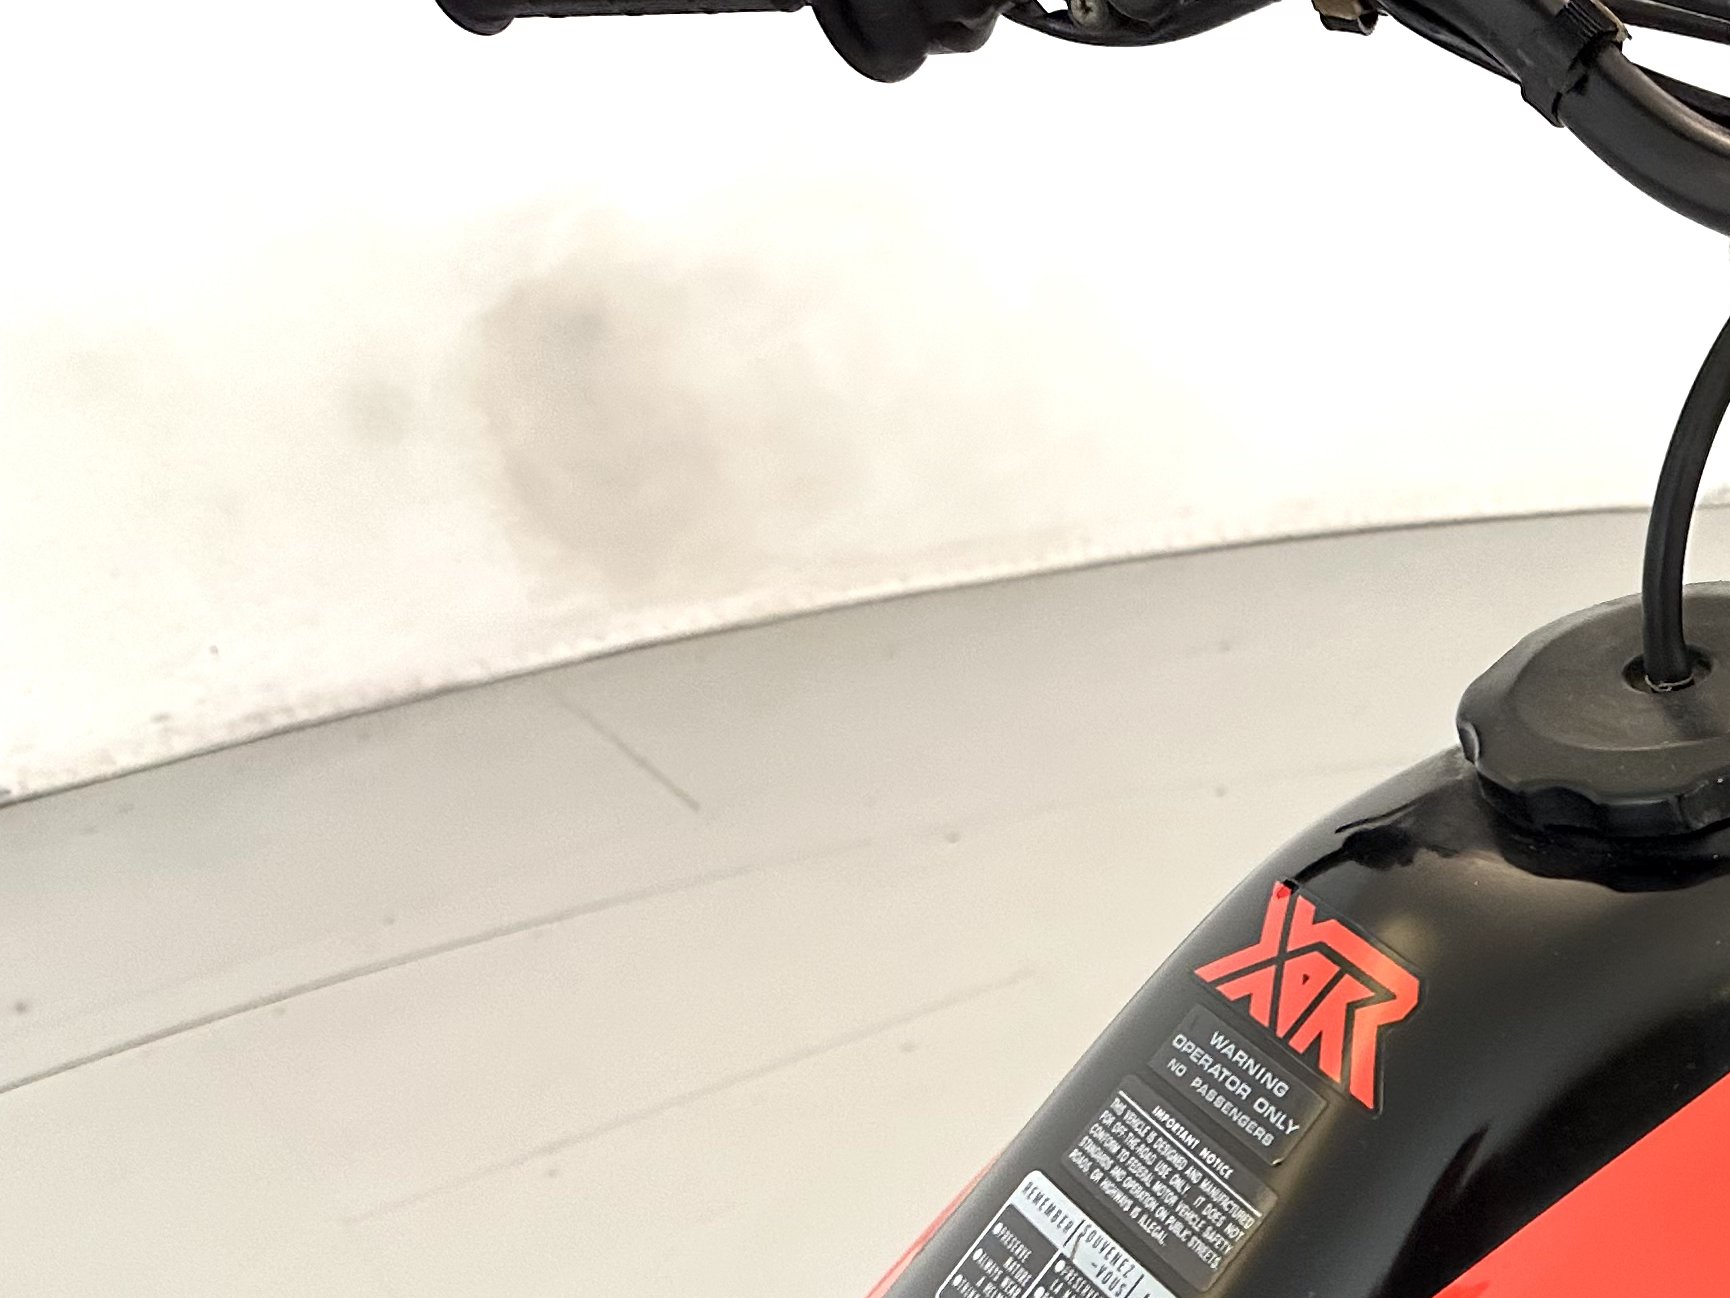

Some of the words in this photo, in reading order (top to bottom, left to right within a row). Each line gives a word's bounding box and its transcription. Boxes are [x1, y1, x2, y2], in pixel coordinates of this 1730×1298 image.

[1194, 881, 1421, 1110] XR
[1169, 1032, 1253, 1101] OPERATOR
[1250, 1095, 1301, 1138] ONLY
[1206, 1029, 1291, 1099] WARNING
[1165, 1056, 1188, 1078] NO
[1189, 1075, 1276, 1148] PASSENGERS
[1097, 1108, 1116, 1129] FOR
[1152, 1158, 1173, 1180] USE
[1192, 1193, 1206, 1210] IT
[1200, 1201, 1227, 1228] DOES
[1222, 1220, 1245, 1244] NOT
[1121, 1108, 1151, 1139] VEHICLE
[1144, 1128, 1158, 1144] IS
[1151, 1135, 1189, 1172] DESIGNED
[1182, 1163, 1204, 1185] AND
[1197, 1176, 1256, 1231] MANUFACTURED
[1151, 1104, 1200, 1151] IMPORTANT
[1197, 1145, 1235, 1180] NOTICE
[1020, 1179, 1076, 1235] REMEMBER
[1087, 1121, 1122, 1156] CONFORM
[1115, 1146, 1131, 1164] TO
[1123, 1154, 1156, 1188] FEDERAL
[1149, 1178, 1179, 1208] MOTOR
[1173, 1199, 1206, 1232] VEHICLE
[1201, 1223, 1234, 1256] SAFETY
[1088, 1166, 1105, 1184] OR
[1128, 1203, 1142, 1220] IS
[1107, 1162, 1128, 1184] AND
[1120, 1174, 1160, 1213] OPERATION
[1153, 1203, 1170, 1222] ON
[1163, 1213, 1192, 1243] PUBLIC
[996, 1225, 1033, 1264] PRESERVE
[1001, 1254, 1033, 1288] NATURE
[1078, 1222, 1136, 1280] SOUVENEZ
[974, 1274, 986, 1289] A
[1047, 1277, 1065, 1296] LA
